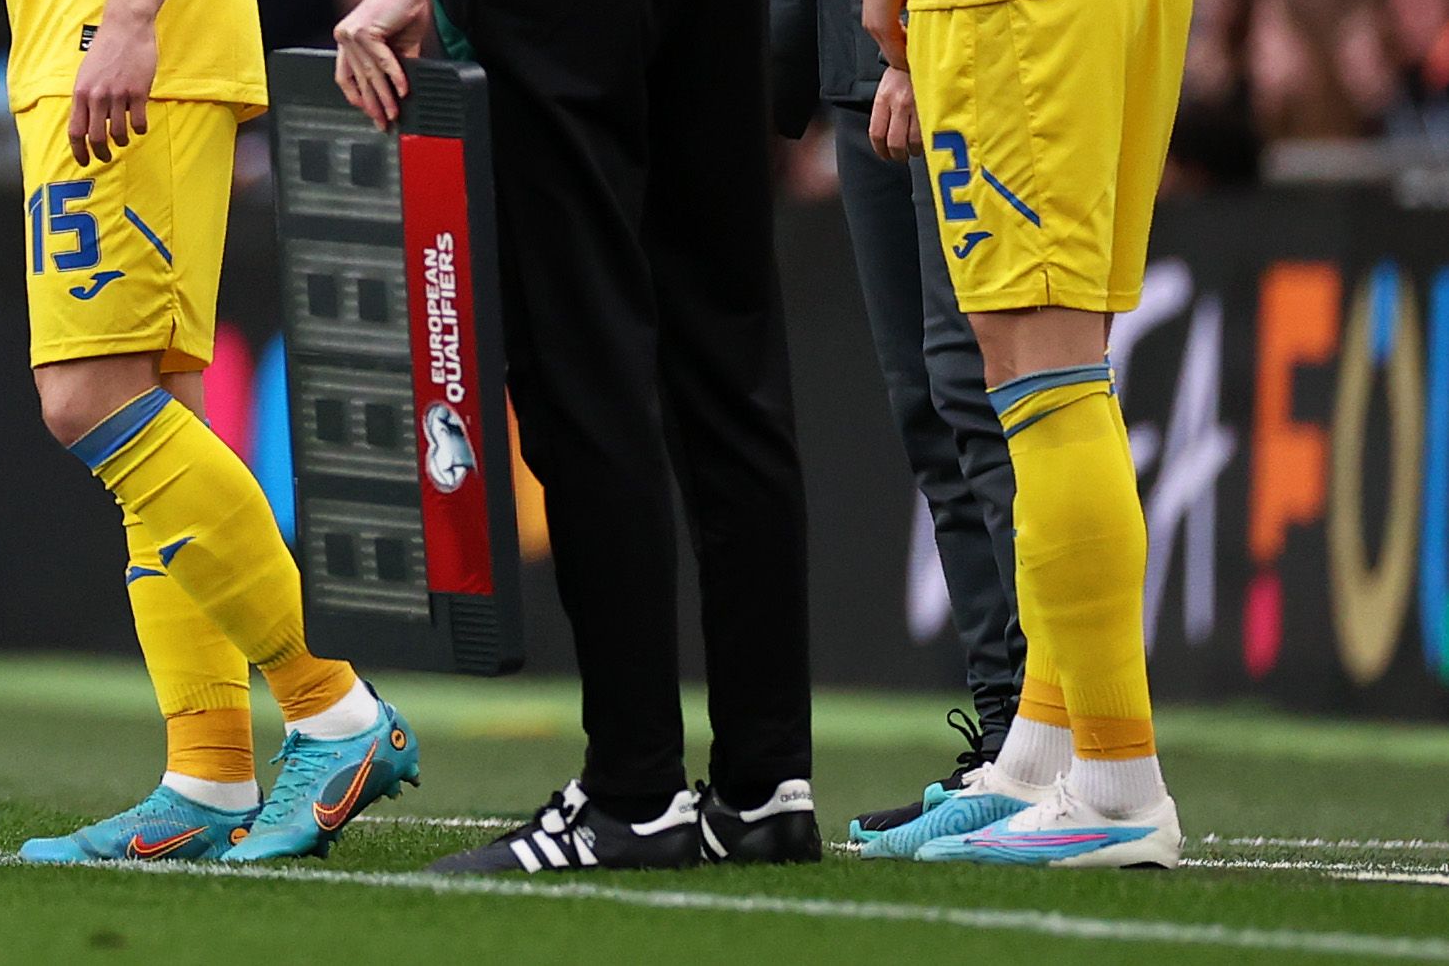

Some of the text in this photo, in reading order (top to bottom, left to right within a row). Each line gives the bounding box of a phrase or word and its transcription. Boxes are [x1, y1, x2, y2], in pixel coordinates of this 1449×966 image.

[28, 178, 101, 275] 15
[932, 129, 978, 222] 2
[423, 248, 445, 384] EUROPEAN
[437, 232, 465, 403] QUALIFIERS
